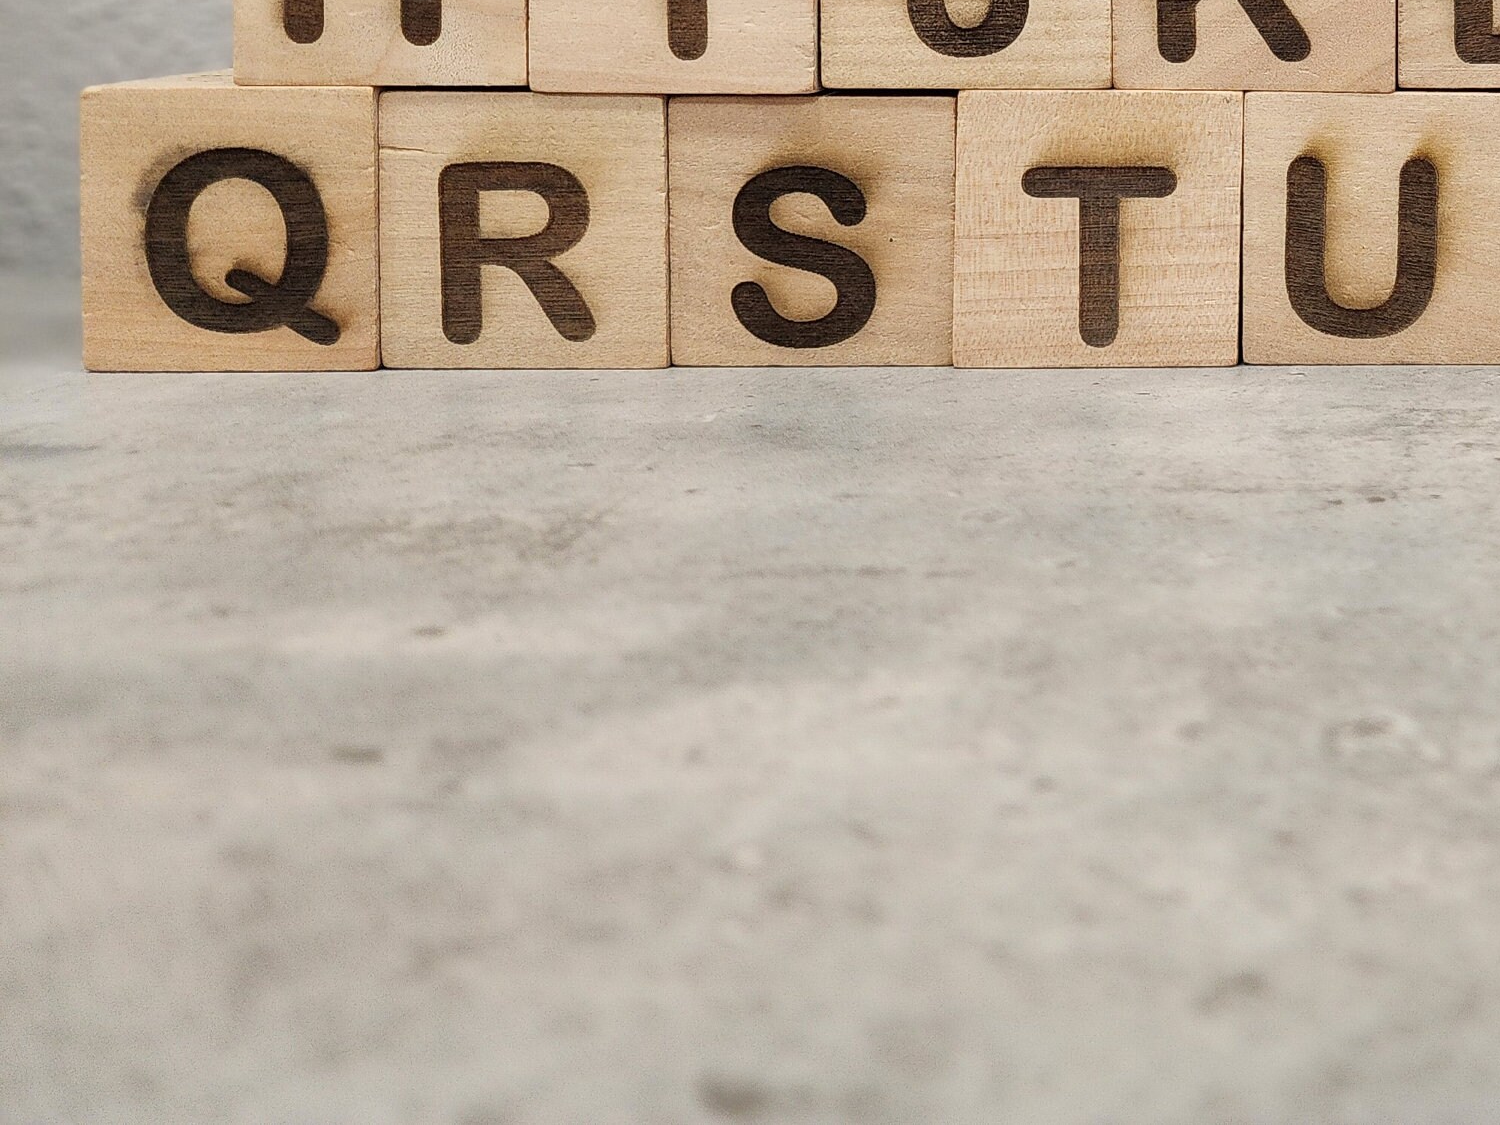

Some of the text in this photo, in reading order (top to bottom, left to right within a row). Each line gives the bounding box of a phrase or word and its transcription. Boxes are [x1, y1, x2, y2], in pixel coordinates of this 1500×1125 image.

[144, 148, 342, 344] Q
[439, 161, 595, 344] R
[731, 166, 877, 349] S
[1022, 164, 1176, 347] T
[1285, 151, 1439, 338] U
